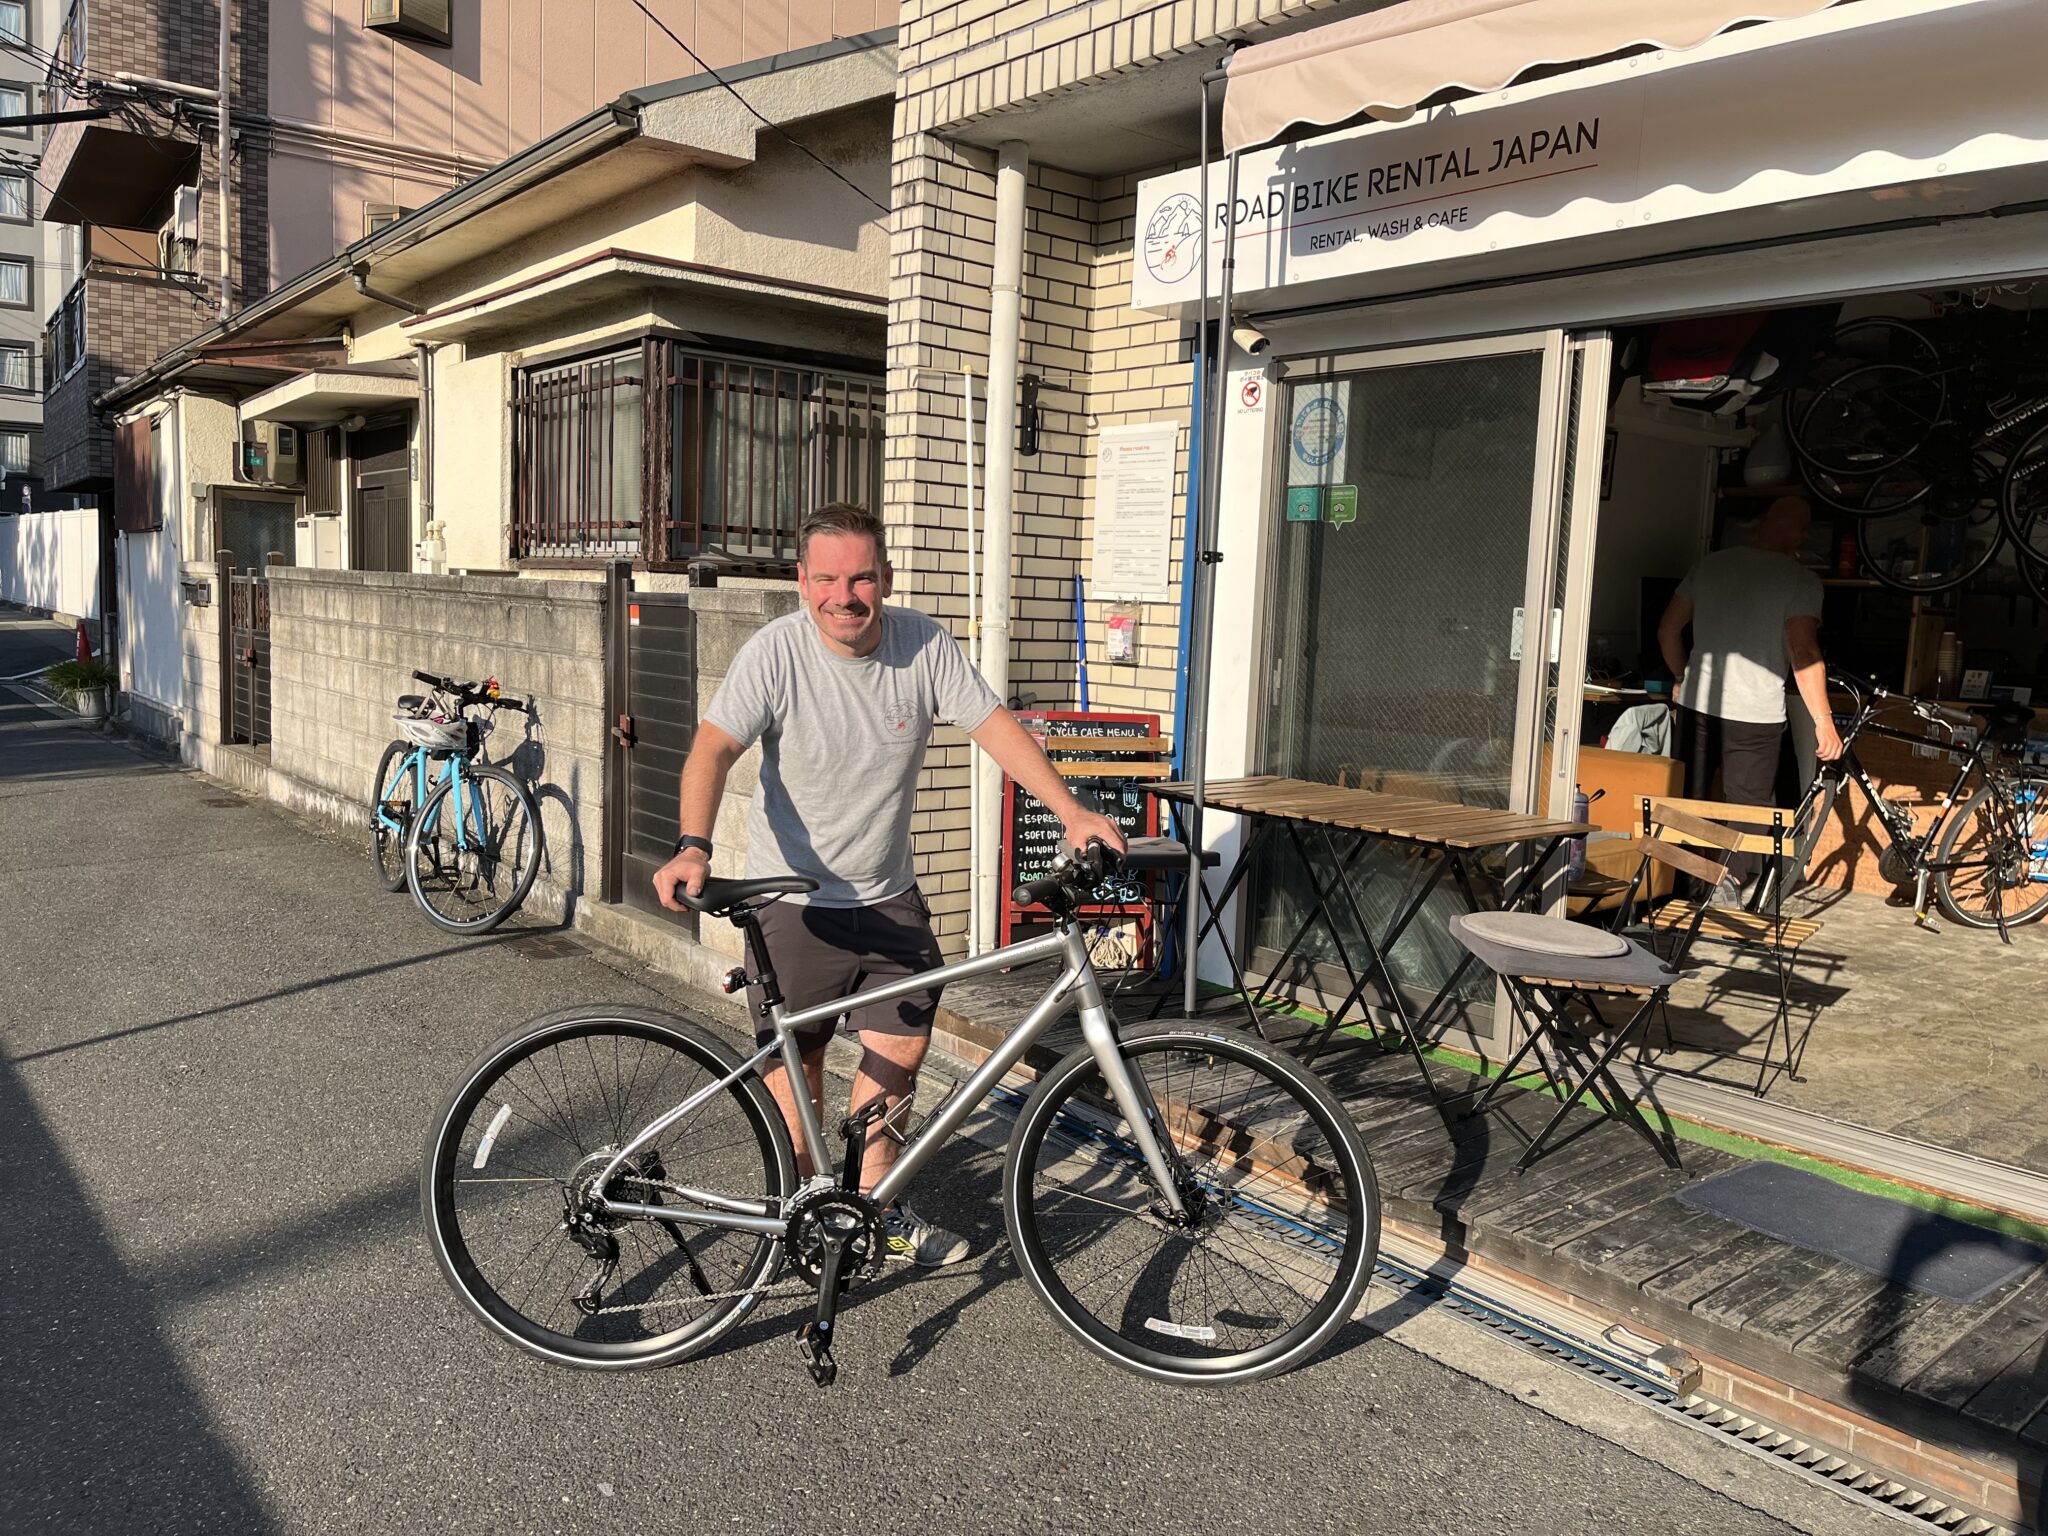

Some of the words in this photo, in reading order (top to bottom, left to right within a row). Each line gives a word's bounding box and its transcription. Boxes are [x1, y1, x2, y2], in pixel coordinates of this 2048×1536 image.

[1215, 191, 1285, 229] ROAD
[1293, 173, 1359, 213] BIKE
[1367, 147, 1480, 196] RENTAL
[1488, 118, 1600, 172] JAPAN
[1310, 227, 1364, 251] RENTAL,
[1367, 217, 1411, 240] WASH
[1413, 215, 1425, 230] &
[1427, 206, 1469, 228] CAFE
[1048, 726, 1078, 737] CYCLE
[1080, 727, 1104, 737] CAFE
[1106, 728, 1136, 737] MENU
[1024, 814, 1061, 825] ESPRES
[1024, 831, 1045, 840] SOFT
[1025, 845, 1054, 854] MINOH
[1023, 860, 1040, 871] ICE
